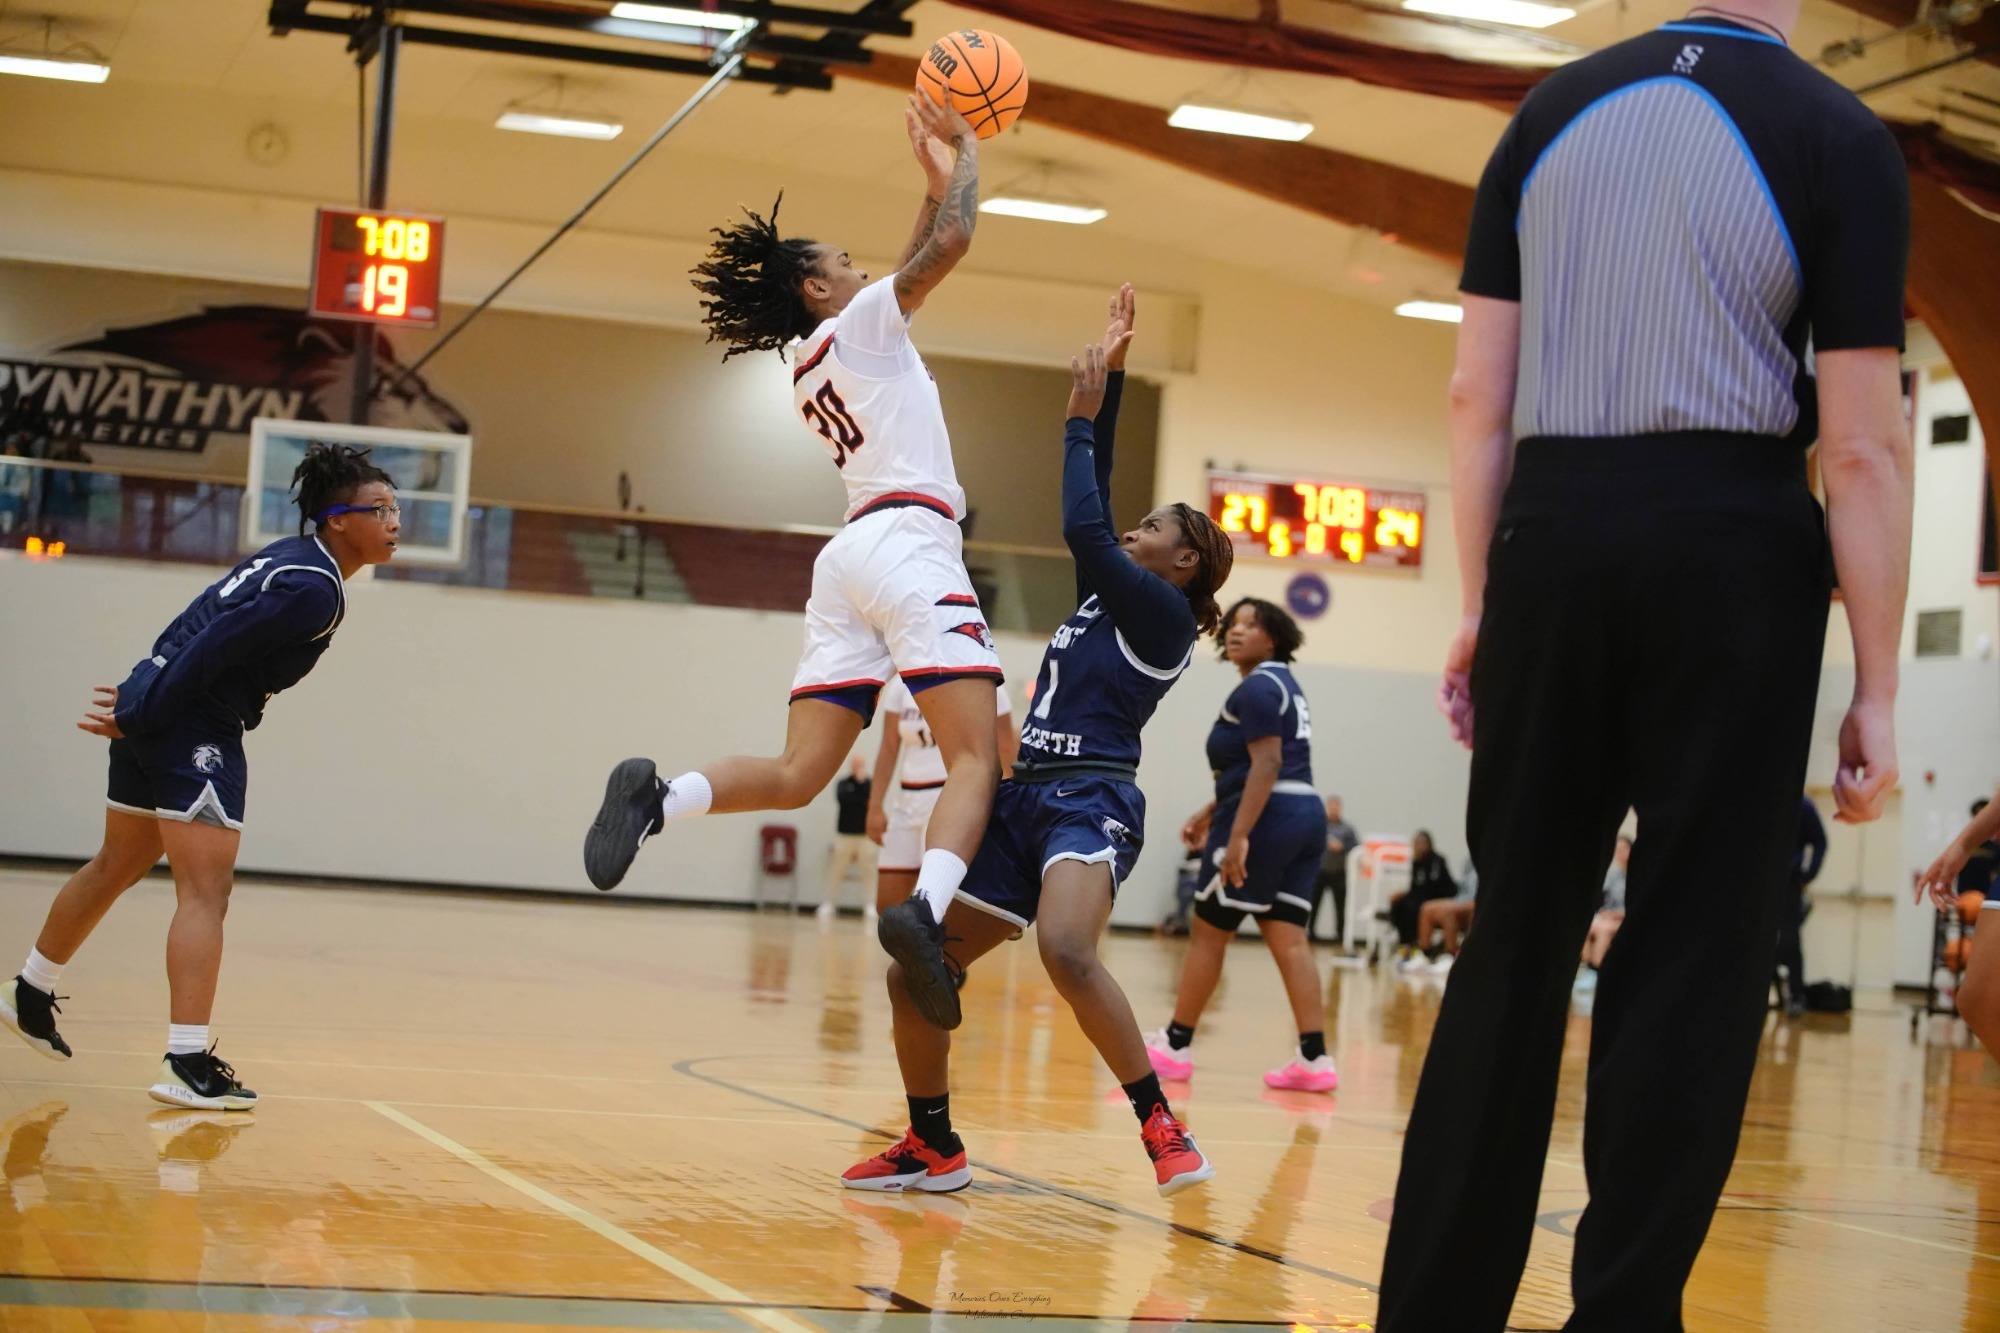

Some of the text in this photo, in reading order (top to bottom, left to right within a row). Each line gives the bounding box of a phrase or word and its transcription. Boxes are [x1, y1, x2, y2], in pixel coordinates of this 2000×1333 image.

[357, 216, 430, 262] 7:08
[363, 264, 409, 316] 19
[802, 378, 865, 470] 30
[1221, 493, 1266, 533] 27
[1374, 507, 1420, 547] 24
[1268, 523, 1291, 557] 5
[1340, 531, 1364, 563] 4
[1034, 660, 1059, 720] 1
